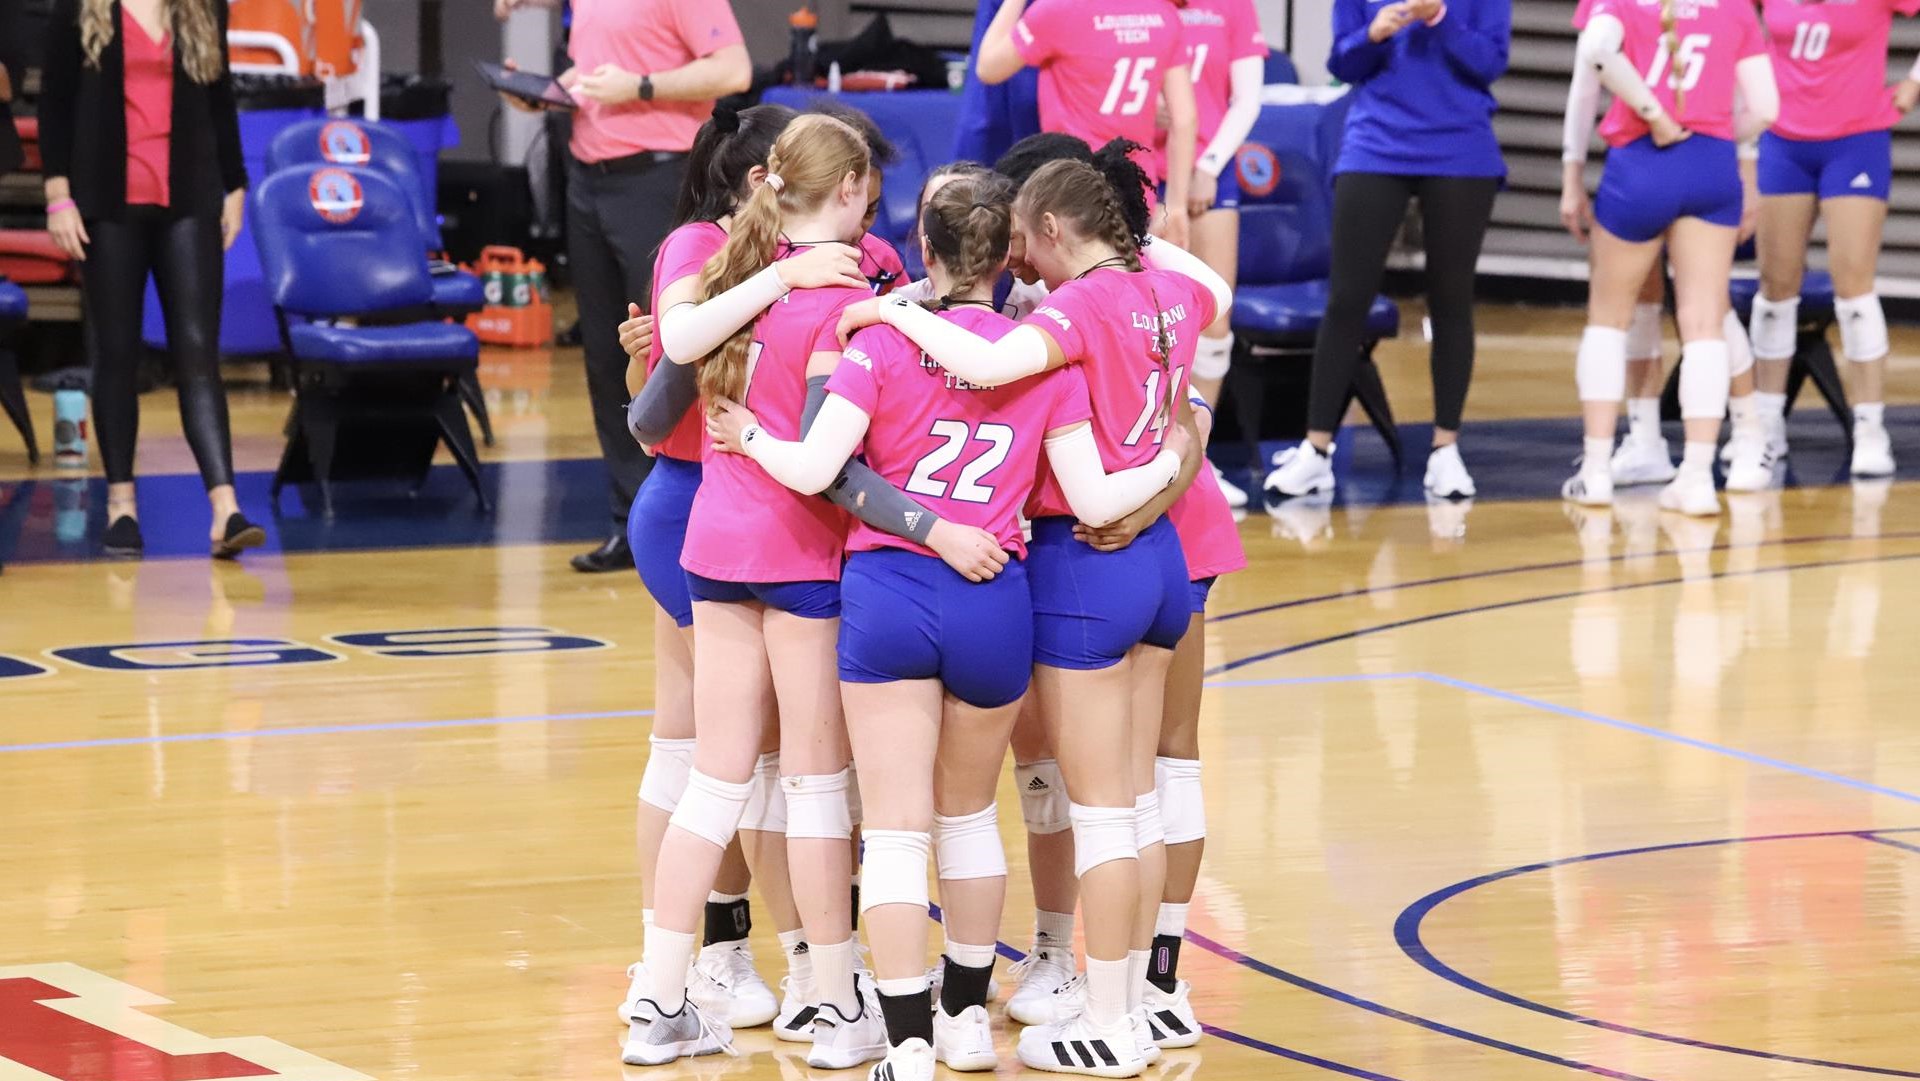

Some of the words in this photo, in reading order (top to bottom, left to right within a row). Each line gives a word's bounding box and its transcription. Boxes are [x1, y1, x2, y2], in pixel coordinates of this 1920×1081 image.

[1790, 21, 1831, 61] 10
[1099, 57, 1156, 115] 15
[1151, 329, 1178, 352] TH
[944, 371, 995, 390] TE
[1121, 364, 1184, 447] 14
[904, 418, 1015, 504] 22
[0, 626, 614, 679] GS
